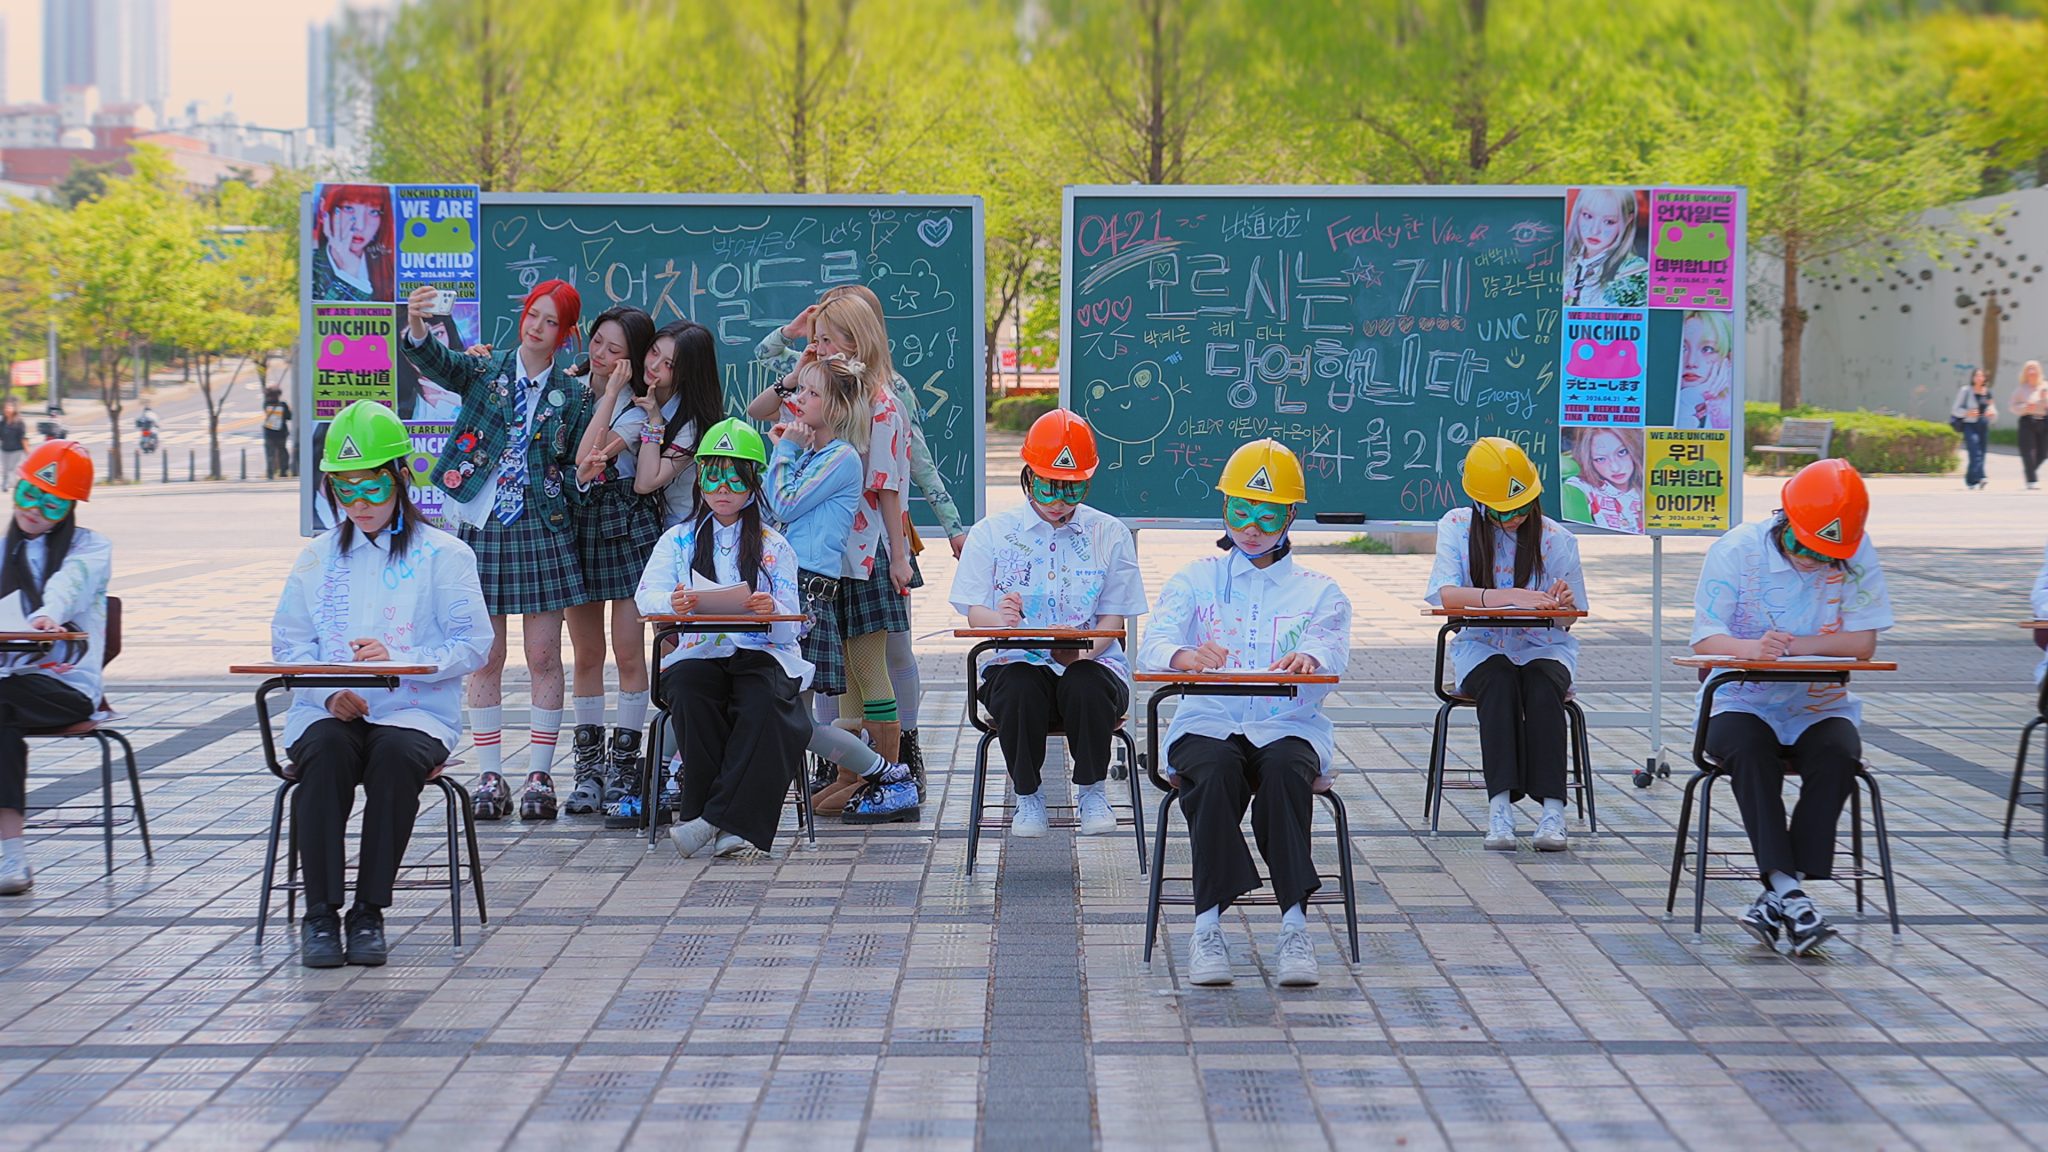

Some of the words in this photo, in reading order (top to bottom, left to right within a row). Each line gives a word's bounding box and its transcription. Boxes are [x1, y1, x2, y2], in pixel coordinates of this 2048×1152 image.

[400, 189, 440, 198] UNCHILD
[444, 189, 474, 198] DEBUT
[1657, 194, 1672, 202] WE
[1673, 194, 1690, 202] ARE
[401, 201, 429, 218] WE
[436, 201, 473, 218] ARE
[1658, 205, 1730, 223] 언차일드
[821, 217, 862, 244] Let's
[1078, 208, 1173, 257] 0421
[401, 253, 474, 269] UNCHILD
[1655, 259, 1728, 274] 데뷔합니다
[1146, 250, 1353, 334] 모르시는
[1393, 256, 1470, 317] 게
[318, 320, 391, 336] UNCHILD
[1144, 324, 1191, 349] 박예은
[1256, 324, 1287, 342] 티나
[1568, 325, 1641, 340] UNCHILD
[317, 369, 391, 386] 正式出道
[1566, 376, 1641, 391] デビューします
[1476, 388, 1538, 420] Energy
[418, 426, 436, 434] ARE
[1650, 432, 1665, 440] WE
[1667, 432, 1686, 440] ARE
[1687, 432, 1725, 441] UNCHILD
[1669, 444, 1704, 461] 우리
[1651, 469, 1723, 487] 데뷔한다
[1401, 478, 1458, 515] 6PM
[1656, 495, 1716, 512] 아이가!
